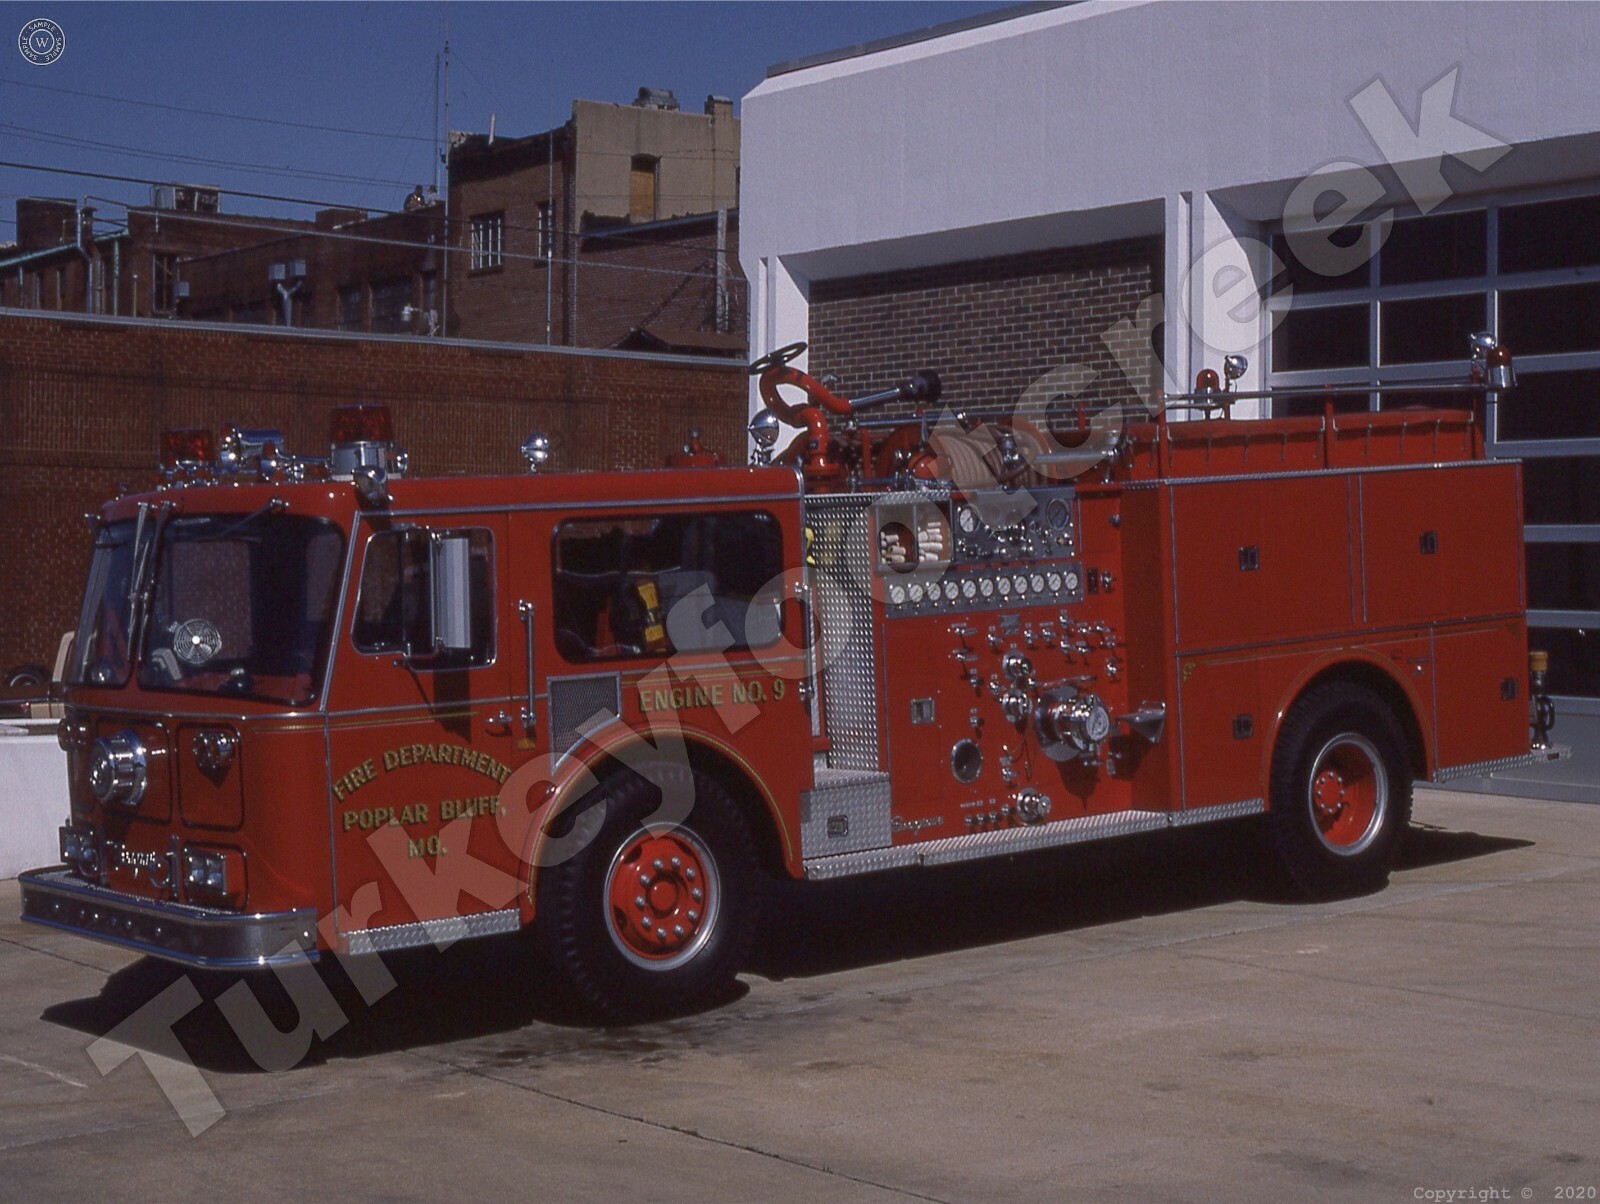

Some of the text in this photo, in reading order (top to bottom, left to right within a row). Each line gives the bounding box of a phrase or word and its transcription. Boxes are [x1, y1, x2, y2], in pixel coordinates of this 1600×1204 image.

[639, 678, 785, 713] ENGINE NO. 9
[332, 743, 512, 801] FIRE DEPARTMENT
[343, 795, 507, 831] POPLAR BLUFF,
